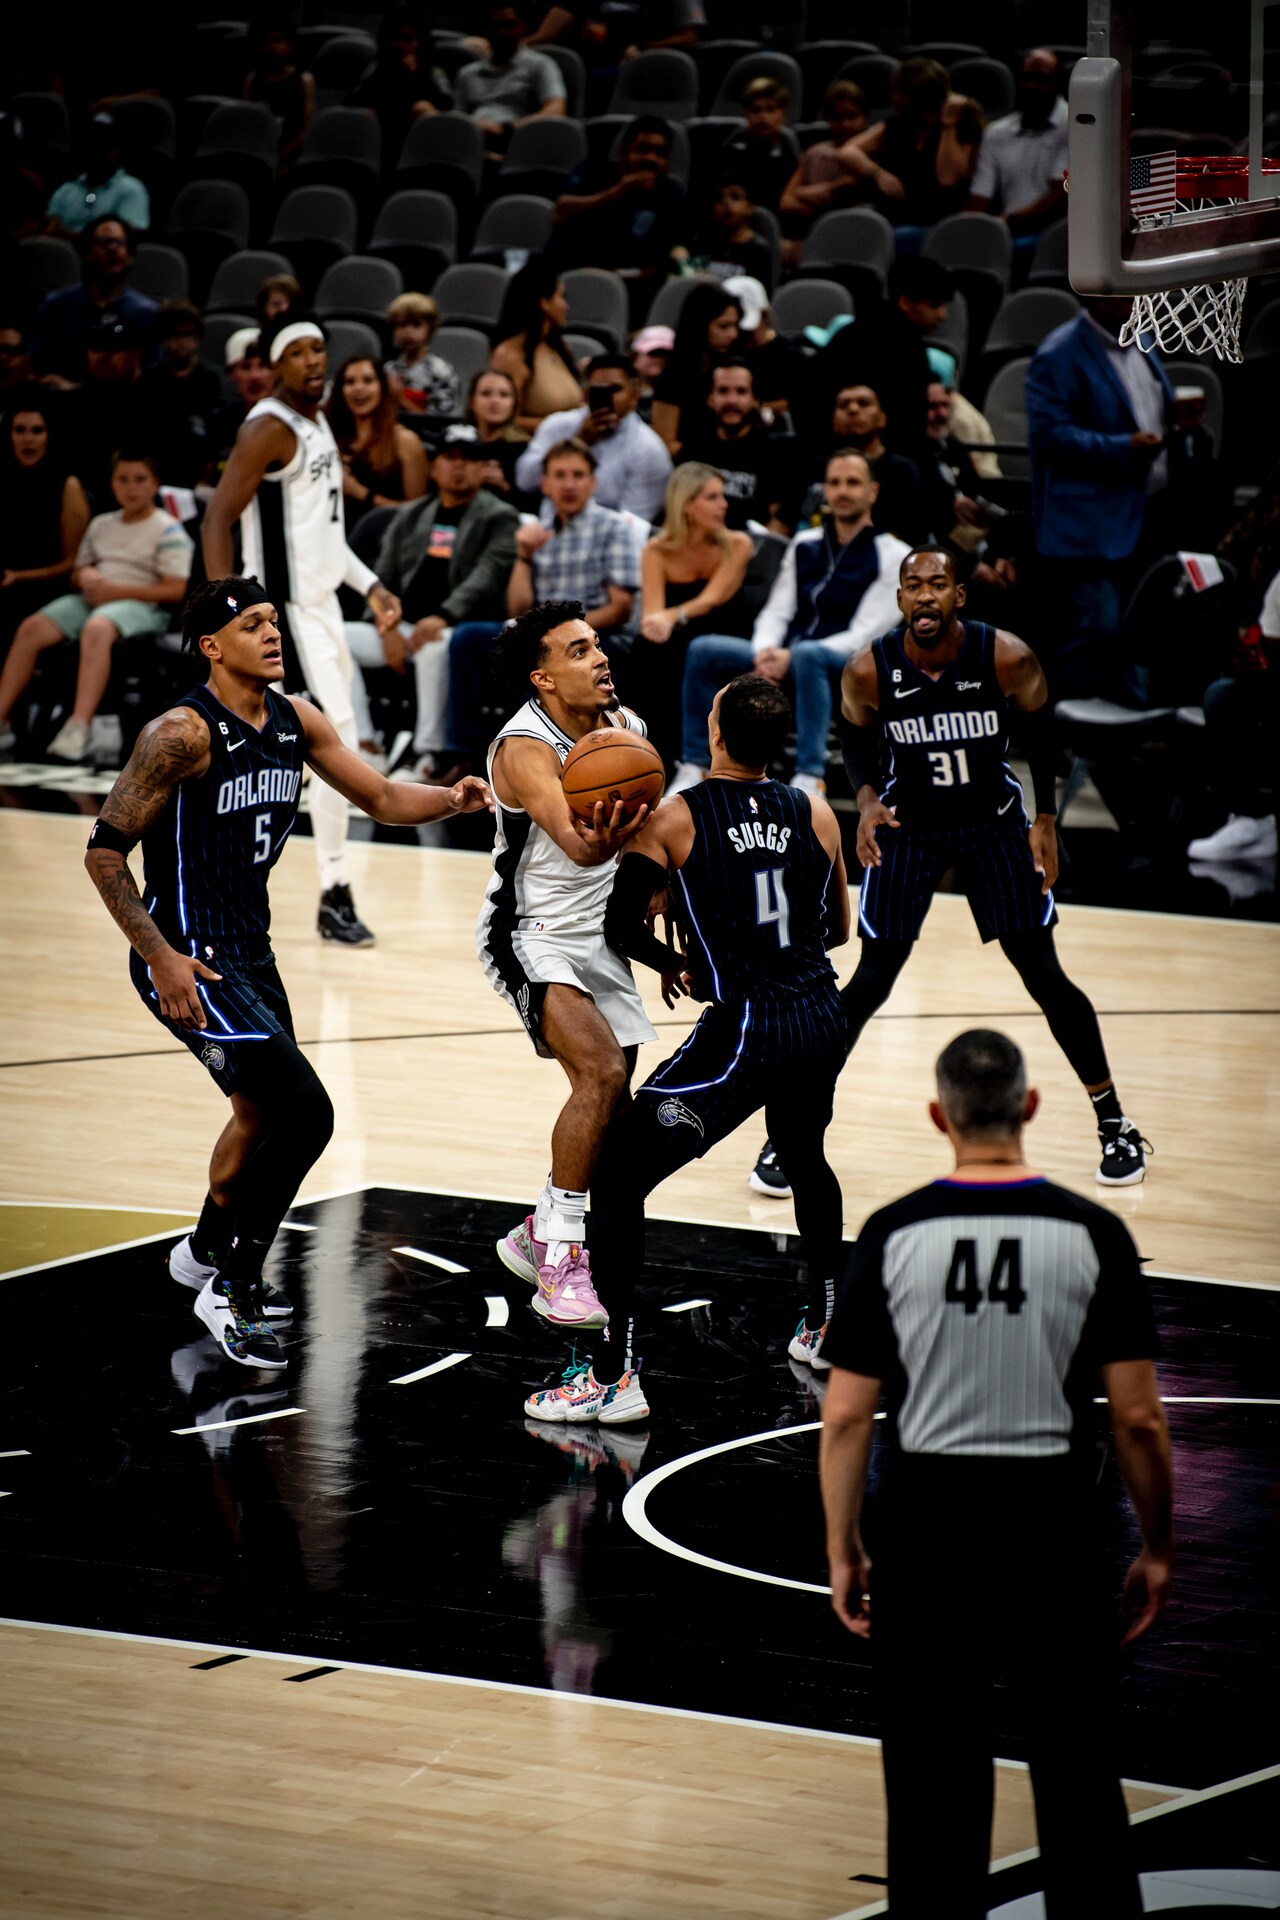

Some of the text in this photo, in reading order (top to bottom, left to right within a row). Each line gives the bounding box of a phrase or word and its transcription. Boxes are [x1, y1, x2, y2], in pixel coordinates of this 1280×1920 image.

[329, 487, 338, 522] 7
[892, 669, 902, 683] 6
[955, 681, 982, 691] Disney
[218, 721, 229, 735] 6
[277, 732, 298, 743] Disney
[888, 710, 999, 744] ORLANDO
[928, 748, 970, 787] 31
[217, 768, 301, 815] ORLANDO
[253, 812, 272, 865] 5
[727, 821, 792, 854] SUGGS
[754, 867, 791, 949] 4
[944, 1237, 1027, 1316] 44
